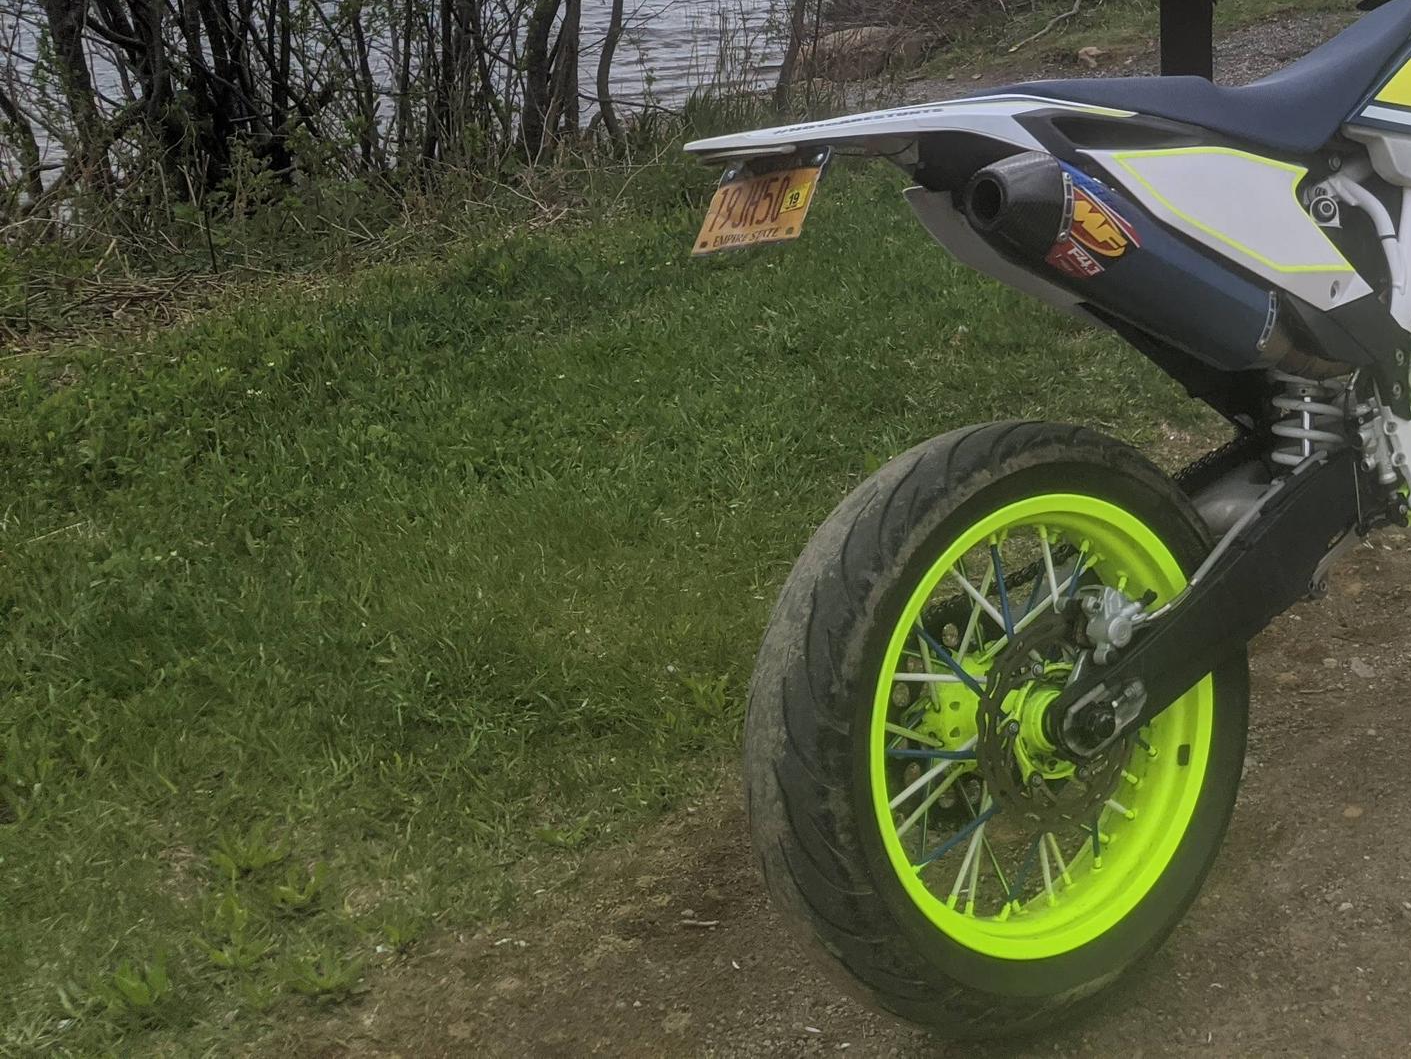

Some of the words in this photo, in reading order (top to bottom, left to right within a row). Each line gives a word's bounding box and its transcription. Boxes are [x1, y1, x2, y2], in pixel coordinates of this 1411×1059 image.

[788, 191, 800, 206] 19
[713, 232, 748, 247] EMPIRE
[749, 227, 782, 240] STATE
